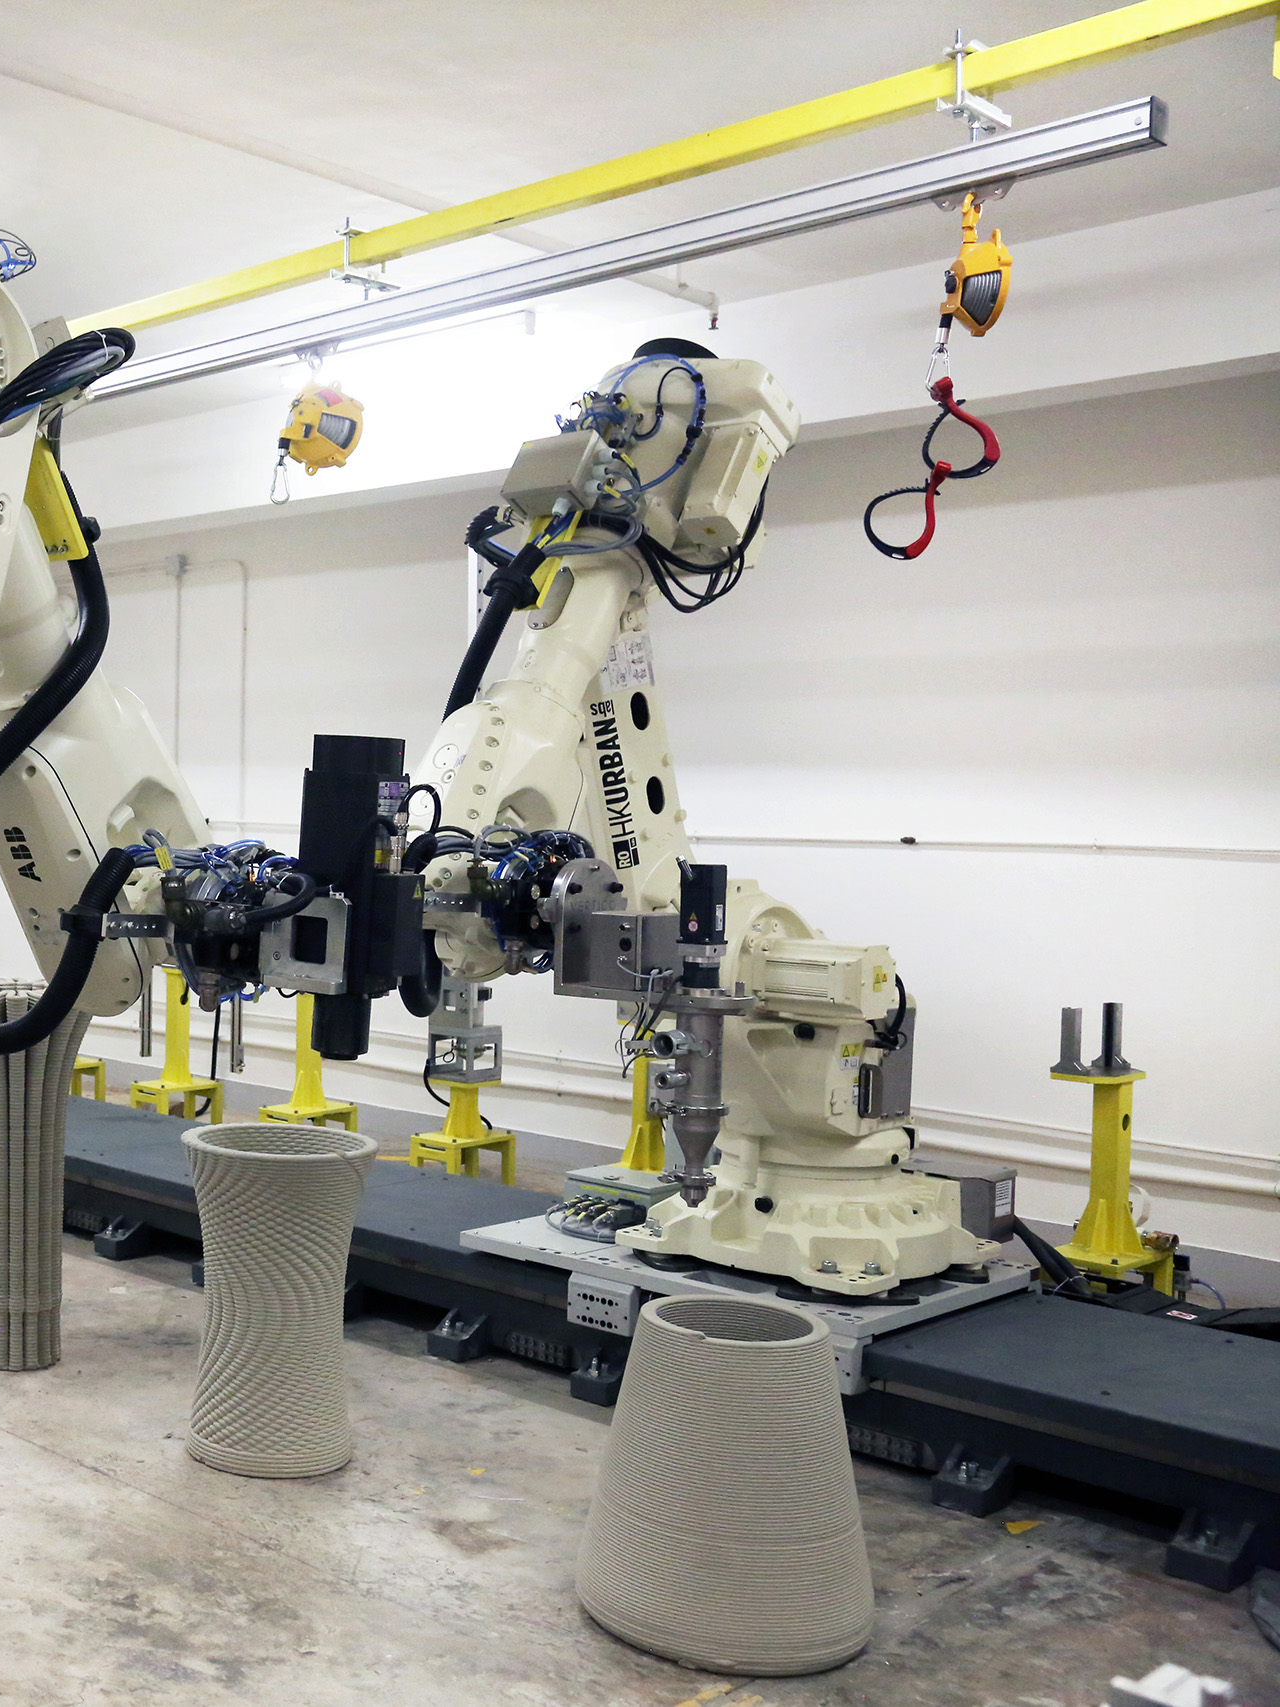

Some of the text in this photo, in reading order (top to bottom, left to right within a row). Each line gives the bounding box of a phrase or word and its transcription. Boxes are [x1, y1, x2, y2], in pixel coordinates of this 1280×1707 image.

[590, 699, 615, 717] labs
[592, 717, 635, 838] HKURBAN
[3, 826, 42, 883] ABB
[617, 850, 632, 868] RO
